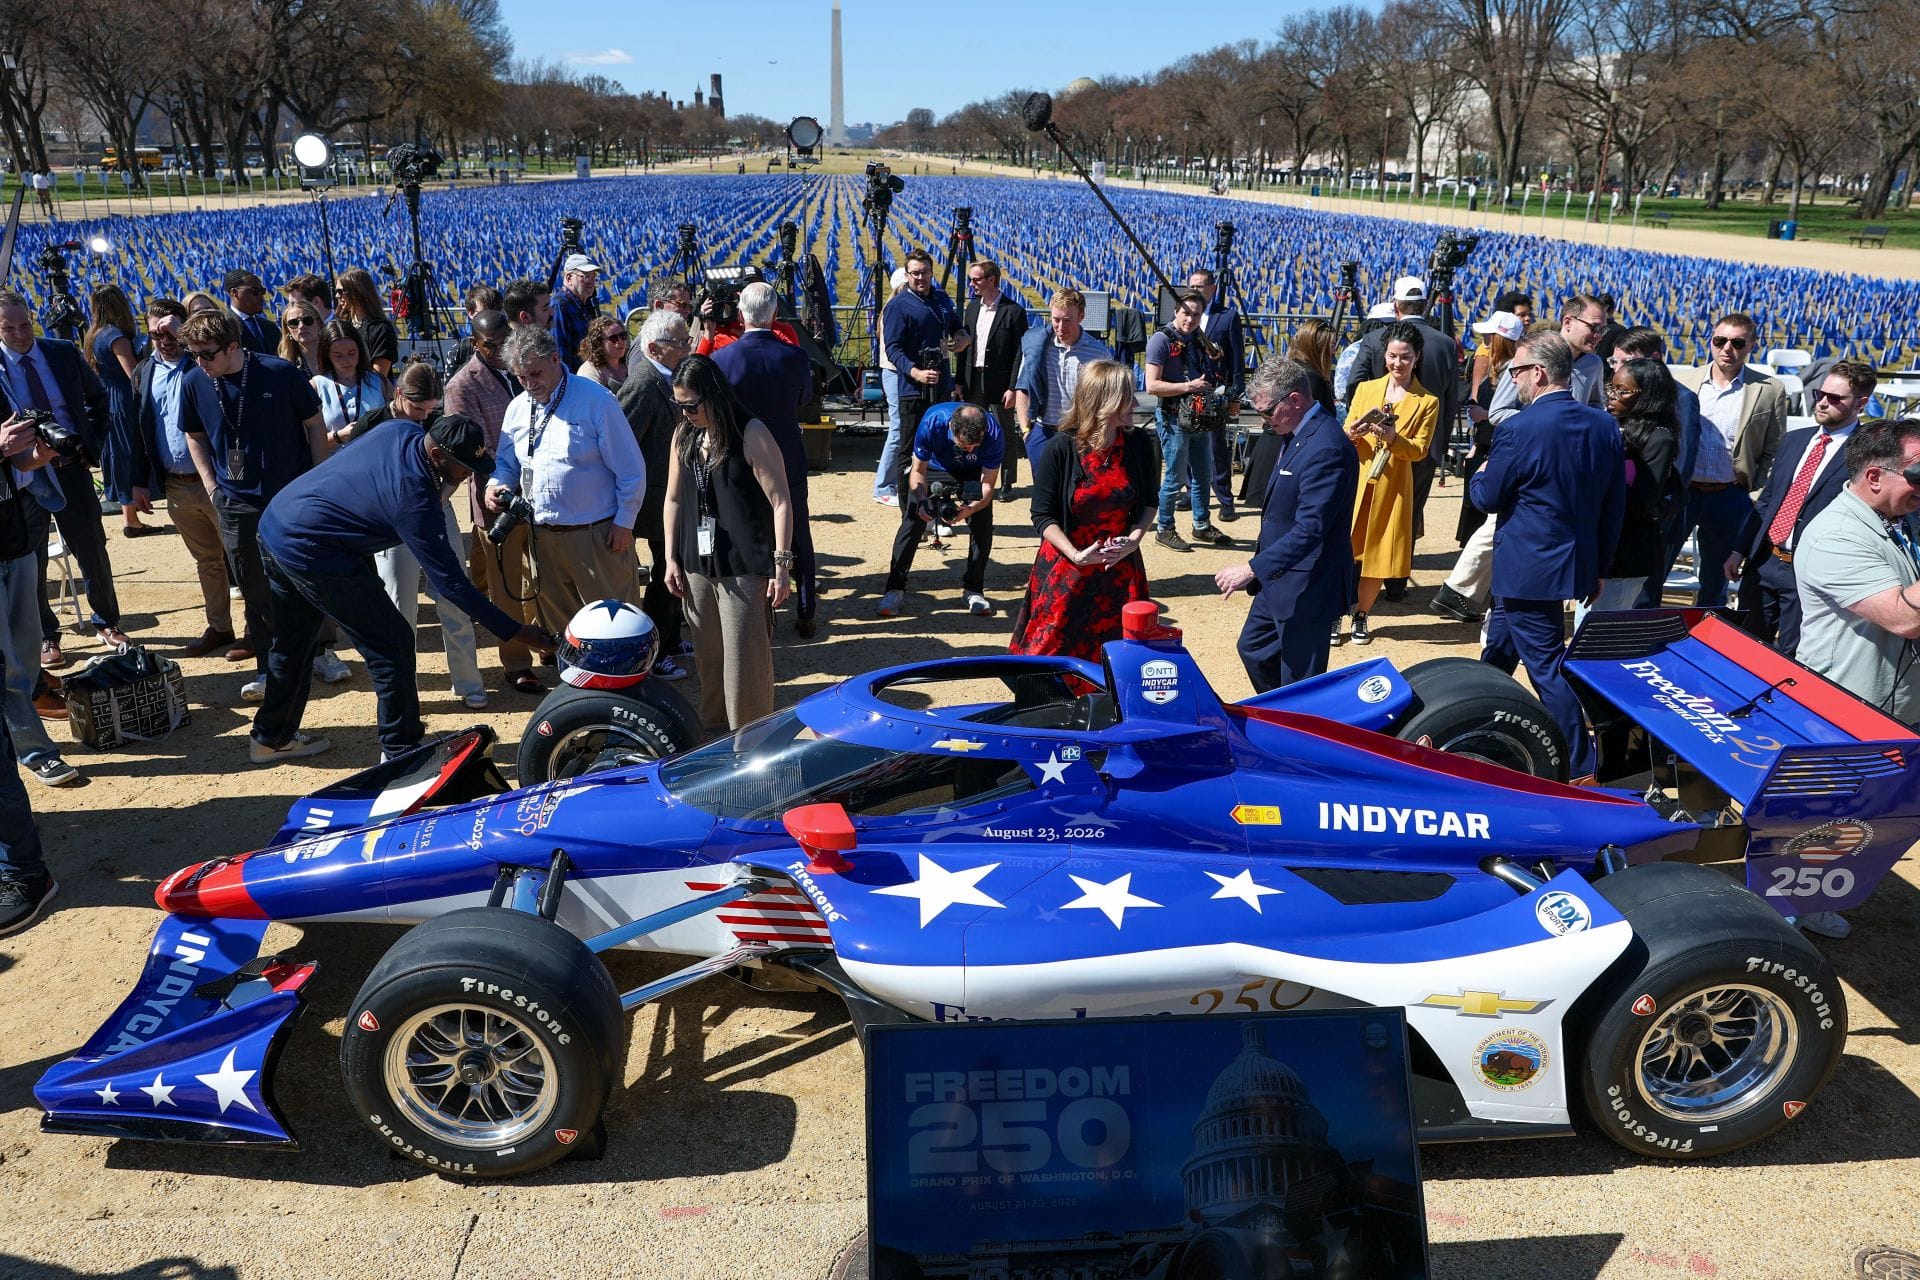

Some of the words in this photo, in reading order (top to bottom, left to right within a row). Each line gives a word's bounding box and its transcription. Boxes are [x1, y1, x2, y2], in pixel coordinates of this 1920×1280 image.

[1142, 678, 1178, 686] INDYCAR
[1156, 667, 1173, 675] NTT
[1368, 680, 1387, 696] FOX
[1620, 660, 1742, 733] Freedom
[612, 706, 676, 754] Fireston
[1493, 710, 1560, 766] Firestone
[1652, 694, 1701, 721] Grand
[1690, 720, 1727, 745] Prix
[1063, 747, 1080, 760] PPG
[471, 816, 487, 850] 2026
[518, 802, 544, 836] 250
[983, 827, 1034, 839] August
[1037, 828, 1060, 841] 23,
[1064, 828, 1105, 838] 2026
[1319, 802, 1491, 839] INDYCAR
[787, 862, 848, 922] Firestone
[1765, 866, 1855, 898] 250
[1542, 906, 1567, 933] SPORTS
[1550, 897, 1585, 928] FOX
[102, 931, 211, 1057] INDYCA
[460, 977, 571, 1045] Firestone
[1746, 956, 1834, 1030] Firestone
[1477, 1030, 1516, 1053] DEPARTMENT
[1529, 1034, 1539, 1043] THE
[1538, 1042, 1548, 1068] INTERIOR
[905, 1065, 1130, 1103] FREEDOM
[1484, 1079, 1506, 1091] MARCH
[1518, 1081, 1533, 1090] 1849
[908, 1097, 1131, 1174] 250
[1607, 1085, 1694, 1152] Firestone
[369, 1113, 477, 1175] Firestone
[911, 1177, 956, 1189] GRAND
[962, 1175, 992, 1186] PRIX
[998, 1174, 1014, 1185] OF
[1020, 1172, 1108, 1184] WASHINGTON,
[1112, 1169, 1137, 1180] D.C.
[969, 1200, 1013, 1210] AUGUST
